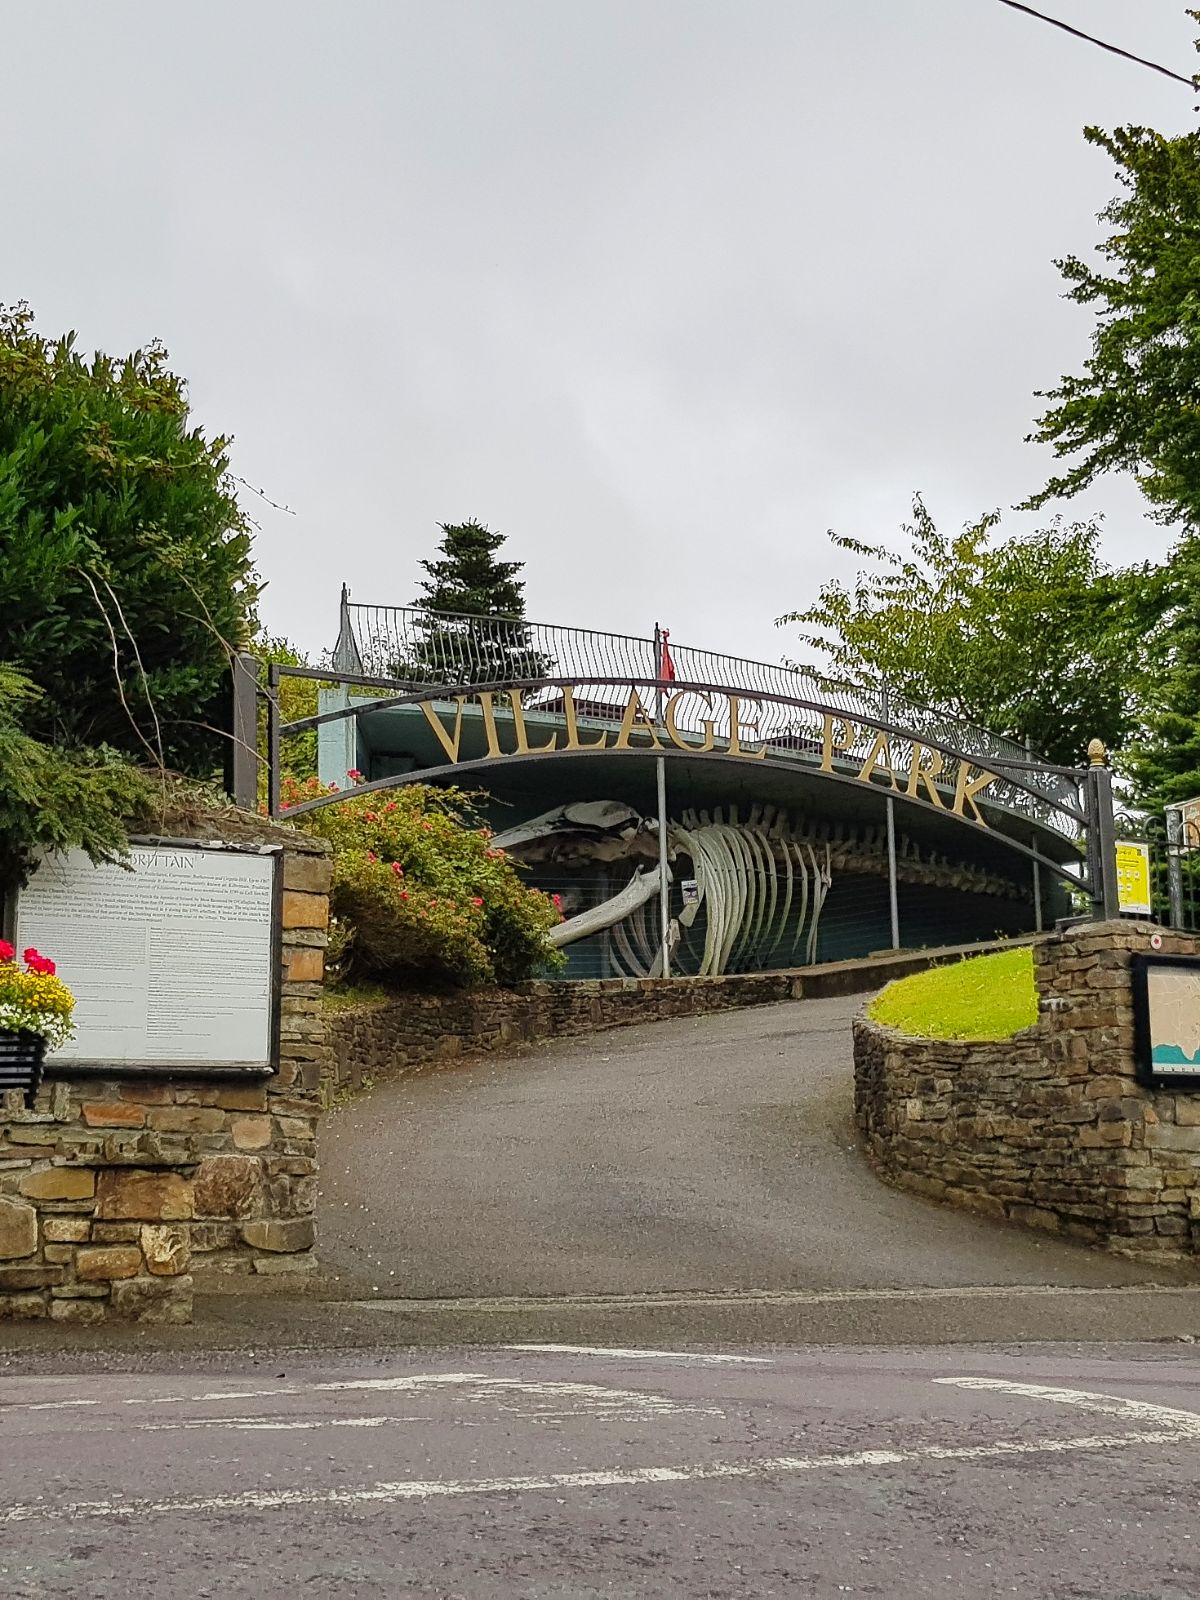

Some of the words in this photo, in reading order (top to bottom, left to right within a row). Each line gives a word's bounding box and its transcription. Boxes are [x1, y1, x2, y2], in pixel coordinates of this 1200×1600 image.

[418, 684, 768, 764] VILLAGE
[819, 713, 999, 828] PARK
[120, 853, 194, 869] BRITTAIN
